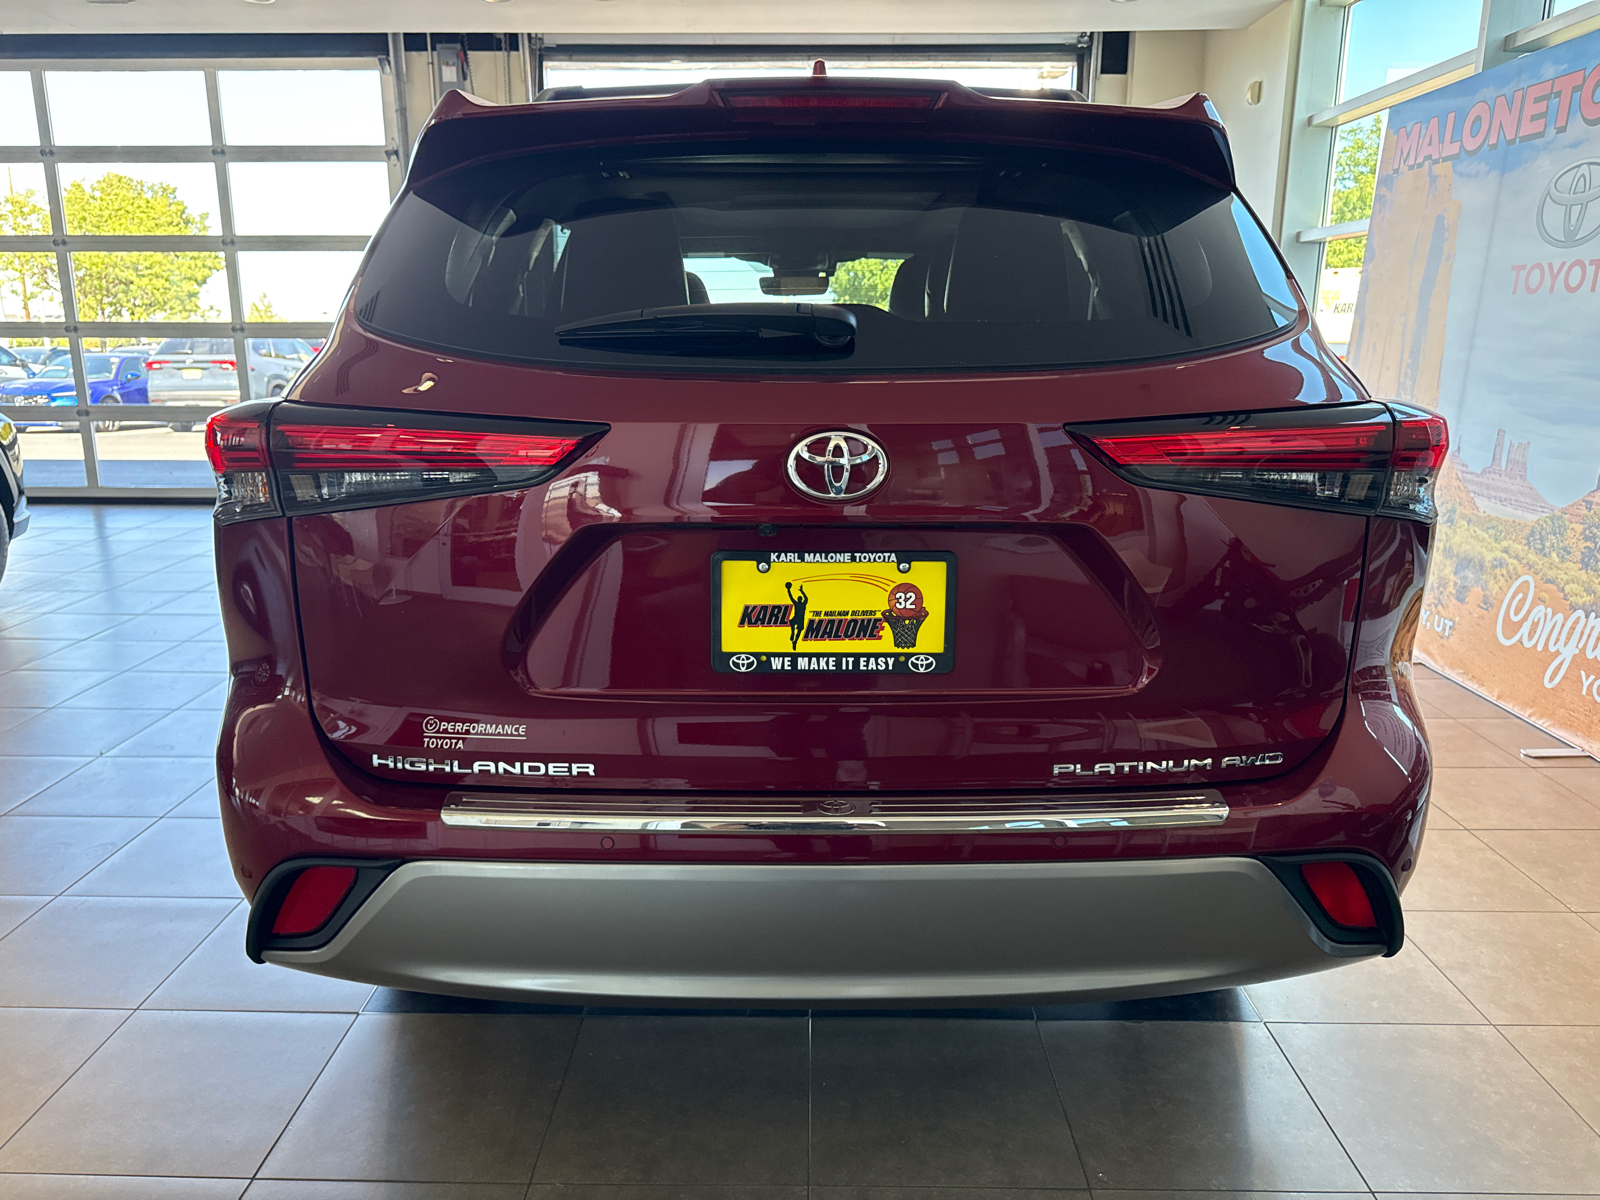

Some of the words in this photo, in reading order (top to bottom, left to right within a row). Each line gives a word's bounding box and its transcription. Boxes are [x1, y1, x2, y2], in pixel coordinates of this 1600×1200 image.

[770, 552, 801, 563] KARL
[804, 552, 851, 563] MALONE
[854, 552, 897, 563] TOYOTA
[895, 592, 916, 609] 32
[737, 604, 793, 627] KARL
[1433, 614, 1454, 637] UT
[802, 617, 886, 641] MALONE
[771, 657, 792, 670] WE
[797, 657, 836, 670] MAKE
[842, 657, 854, 670] IT
[859, 657, 895, 670] EASY
[440, 722, 527, 735] PERFORMANCE
[423, 737, 464, 749] TOYOTA
[371, 753, 596, 777] HIGHLANDER
[1052, 757, 1213, 777] PLATINUM
[1221, 751, 1283, 769] AWD
